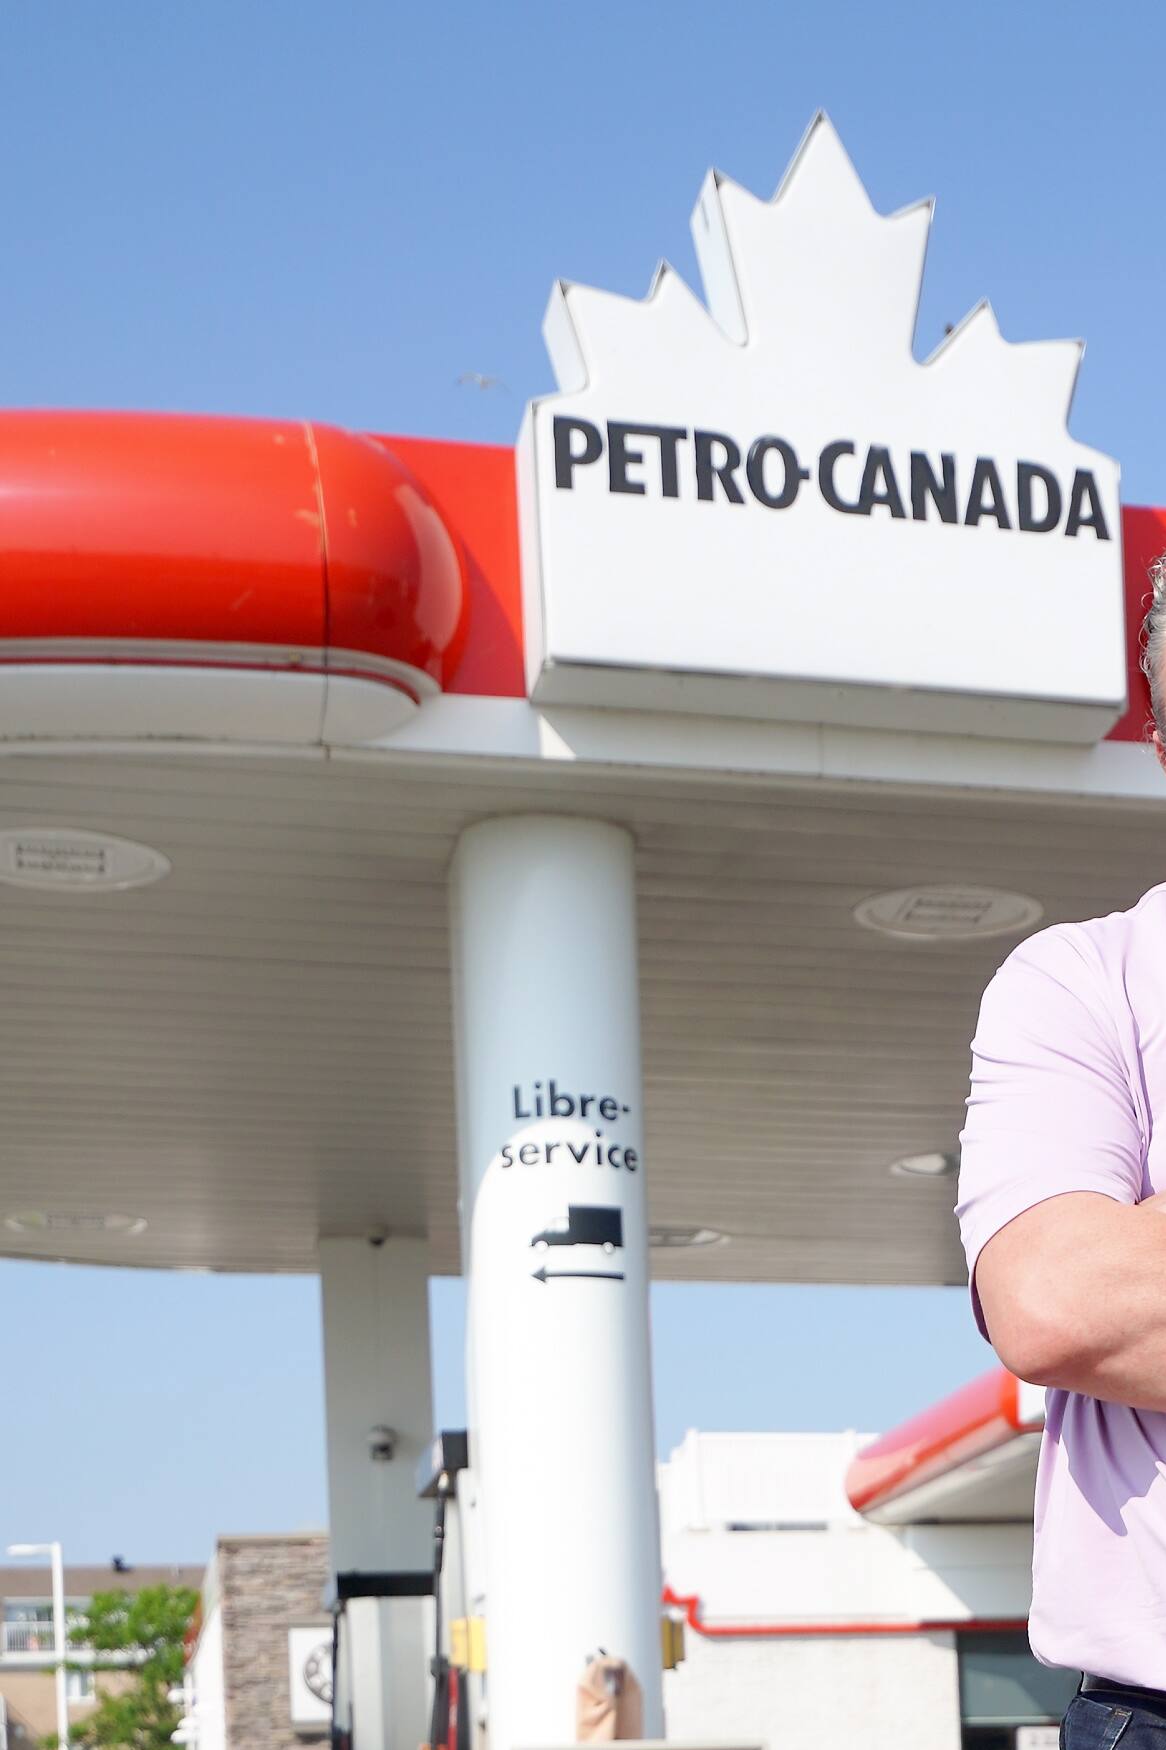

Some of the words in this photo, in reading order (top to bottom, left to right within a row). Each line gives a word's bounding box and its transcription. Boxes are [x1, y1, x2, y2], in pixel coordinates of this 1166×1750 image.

[552, 415, 1112, 541] PETRO-CANADA
[513, 1079, 632, 1121] Libre-
[501, 1128, 640, 1174] service
